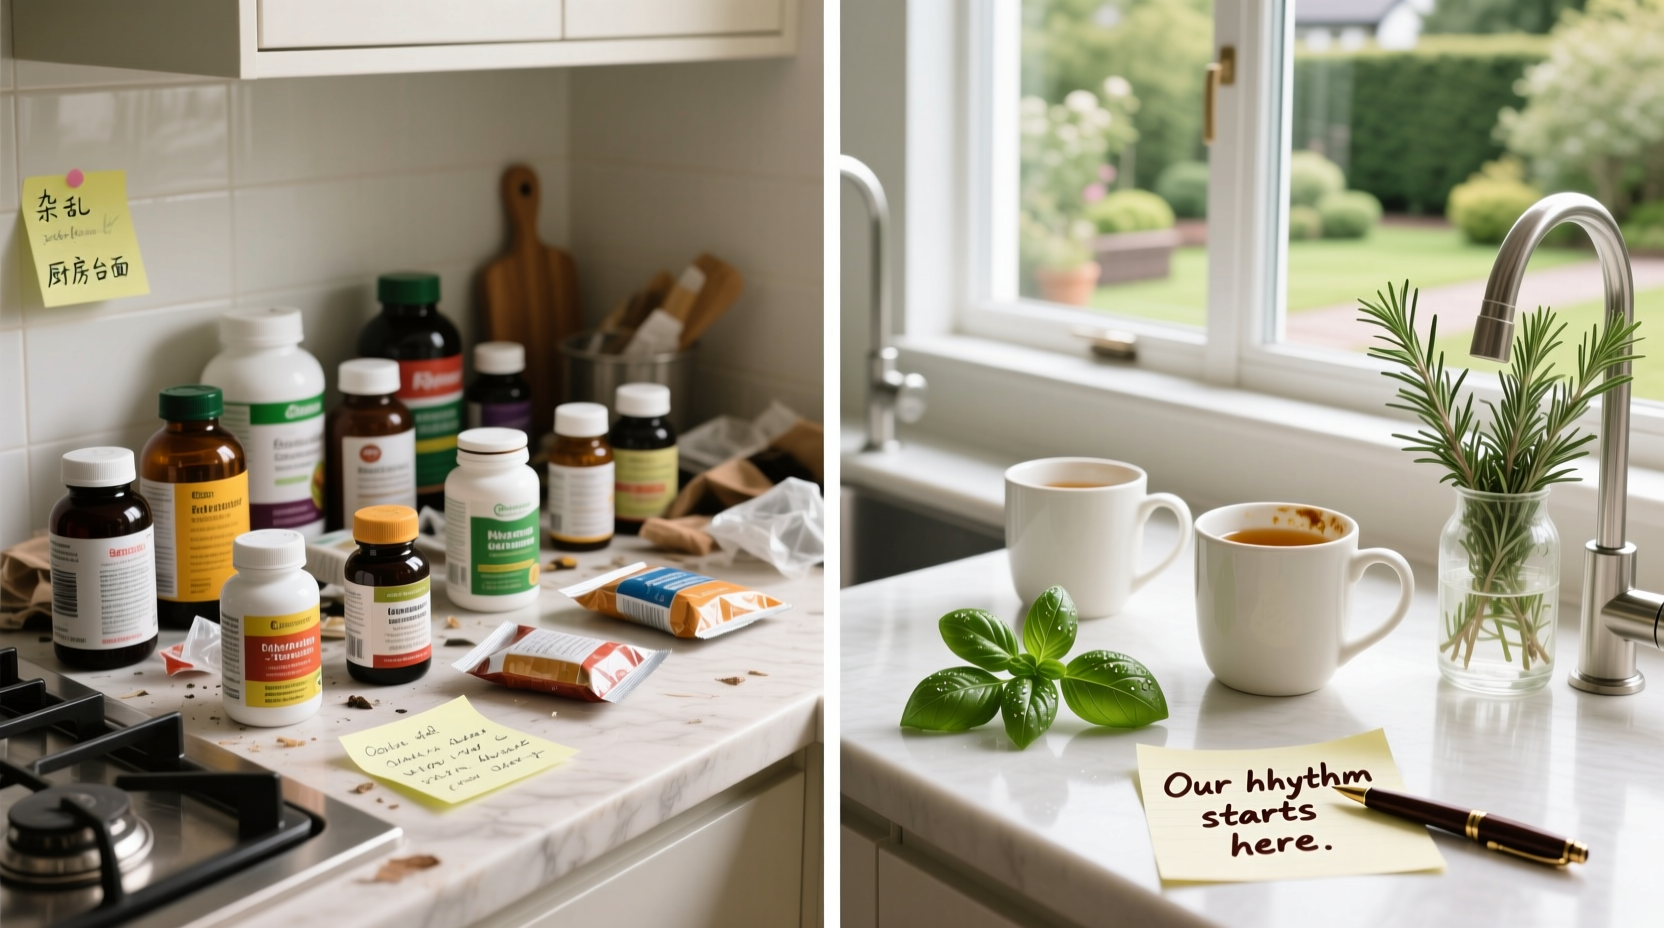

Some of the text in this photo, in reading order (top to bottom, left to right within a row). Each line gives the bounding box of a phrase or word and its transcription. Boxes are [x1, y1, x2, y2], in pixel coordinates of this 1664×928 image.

[36, 188, 91, 223] 杂乱
[47, 255, 129, 288] 厨房台面
[1163, 761, 1373, 800] Our hhythm
[1202, 800, 1317, 828] starts
[1231, 832, 1333, 857] here.
